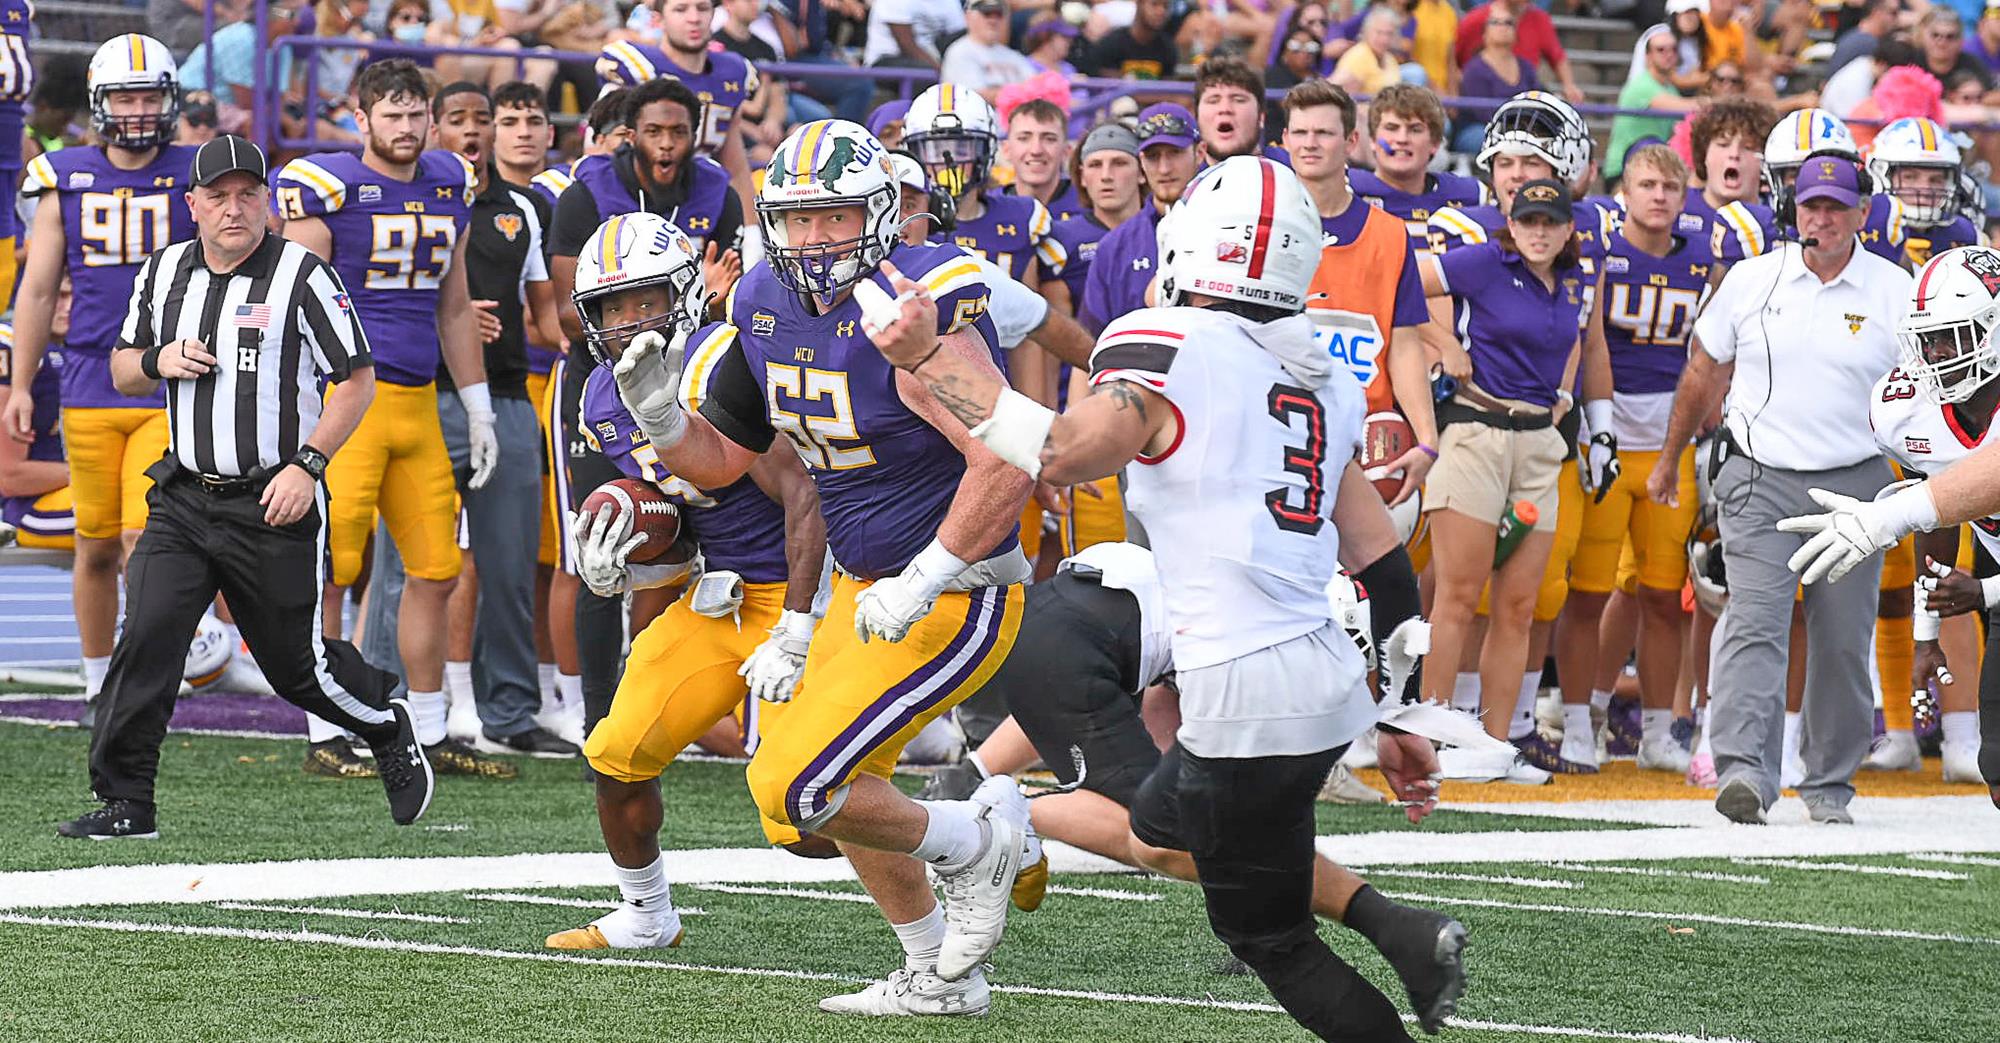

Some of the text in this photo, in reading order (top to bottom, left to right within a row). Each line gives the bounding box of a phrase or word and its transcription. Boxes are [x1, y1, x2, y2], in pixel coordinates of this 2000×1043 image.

[81, 191, 170, 267] 90
[364, 213, 456, 289] 93
[597, 272, 628, 285] Riddell
[1609, 282, 1700, 346] 40
[238, 346, 257, 372] H
[794, 346, 815, 363] WCU
[1313, 331, 1375, 367] AC
[766, 361, 878, 470] 62
[1265, 382, 1328, 537] 3
[1905, 440, 1931, 451] PSAC
